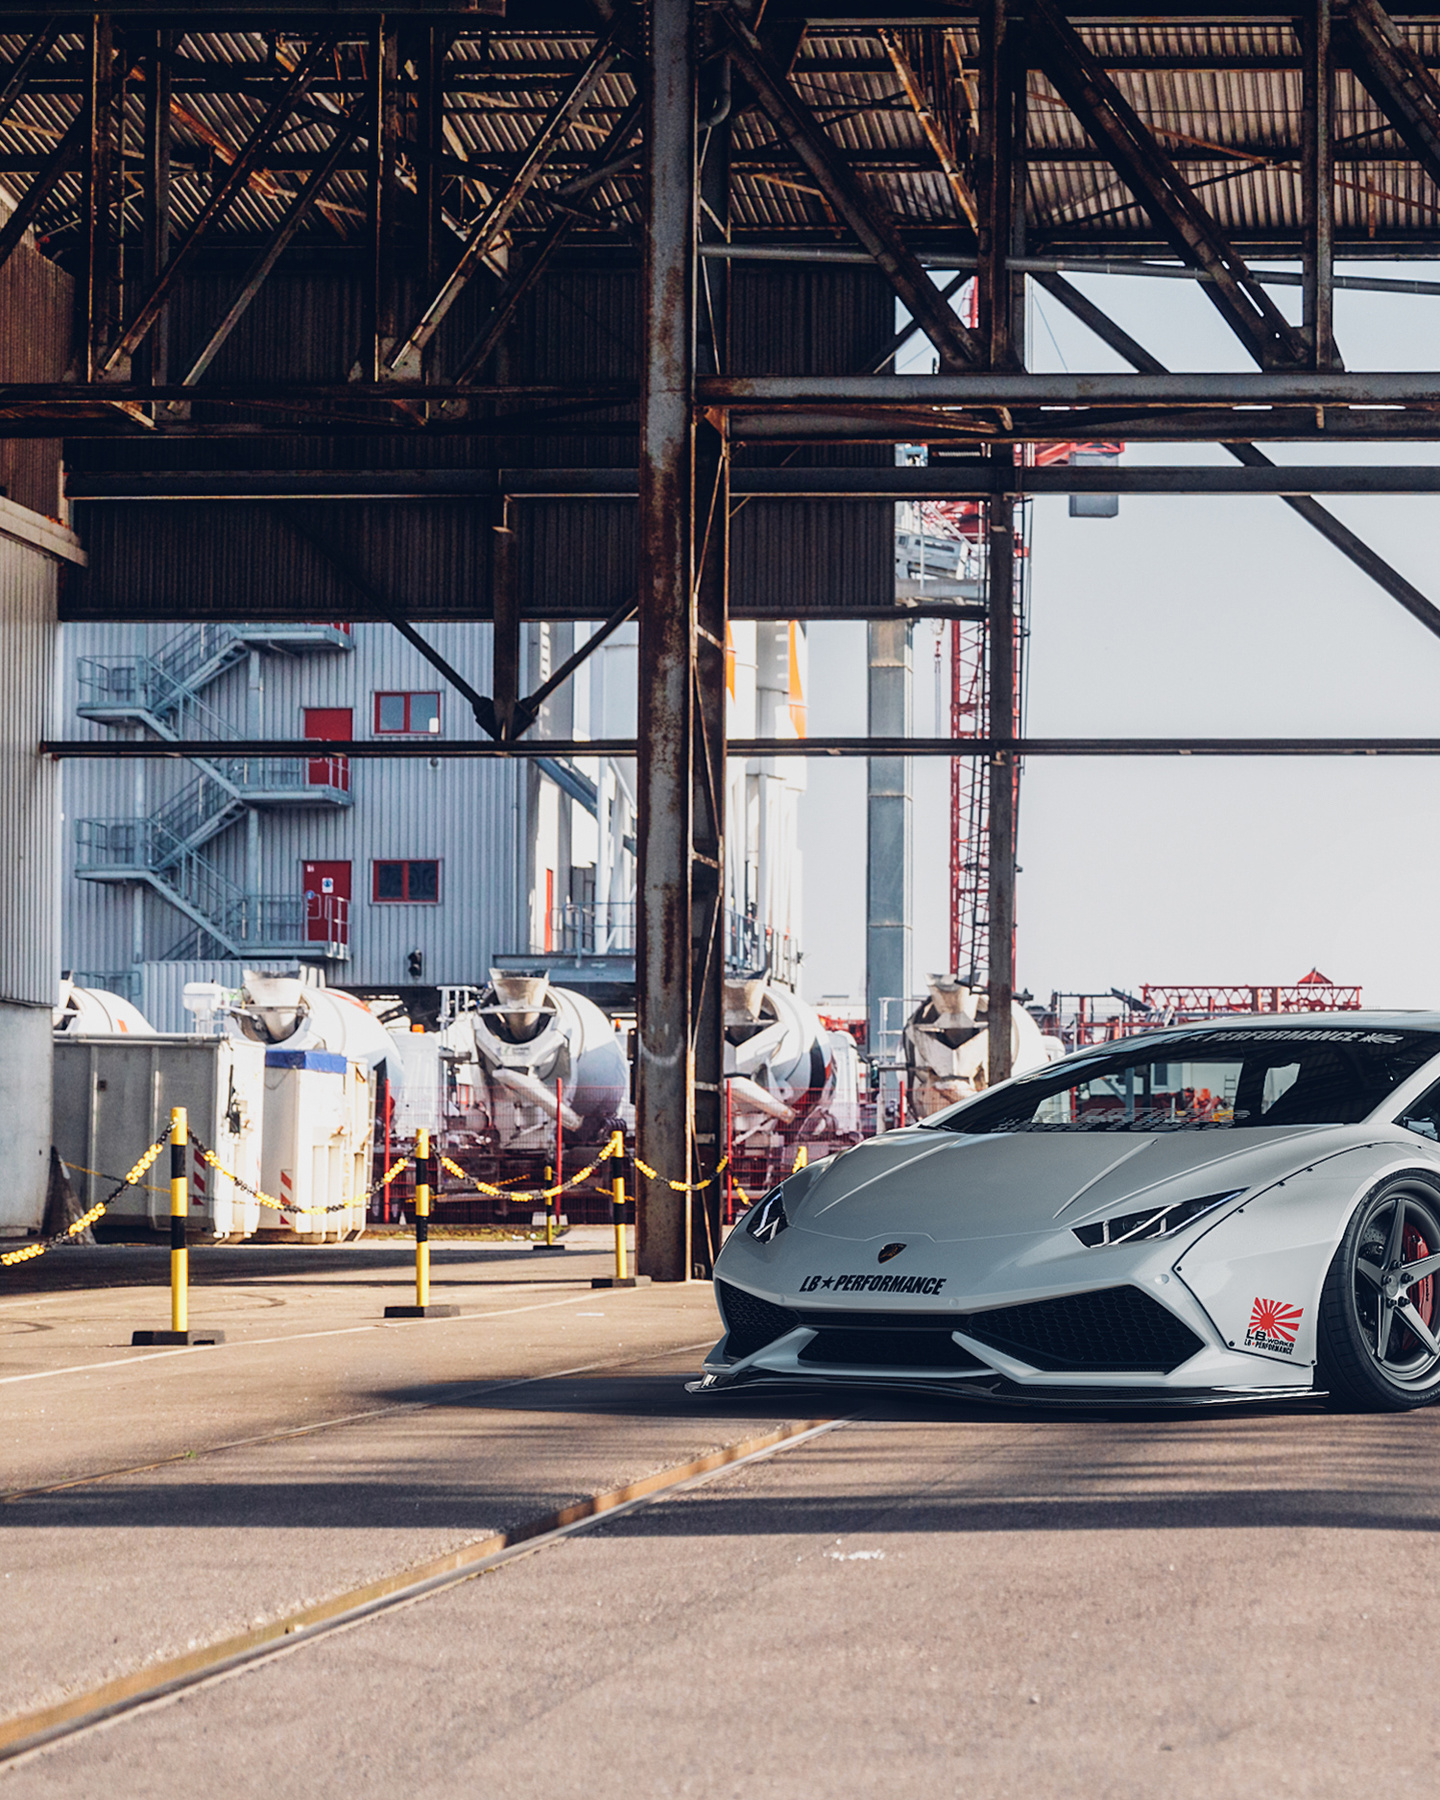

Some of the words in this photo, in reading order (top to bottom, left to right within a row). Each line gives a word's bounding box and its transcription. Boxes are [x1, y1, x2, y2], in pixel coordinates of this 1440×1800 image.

[1202, 1030, 1364, 1043] PERFORMANCE
[799, 1275, 823, 1293] LB
[832, 1274, 947, 1296] PERFORMANCE
[1255, 1341, 1293, 1355] PERFORMANCE
